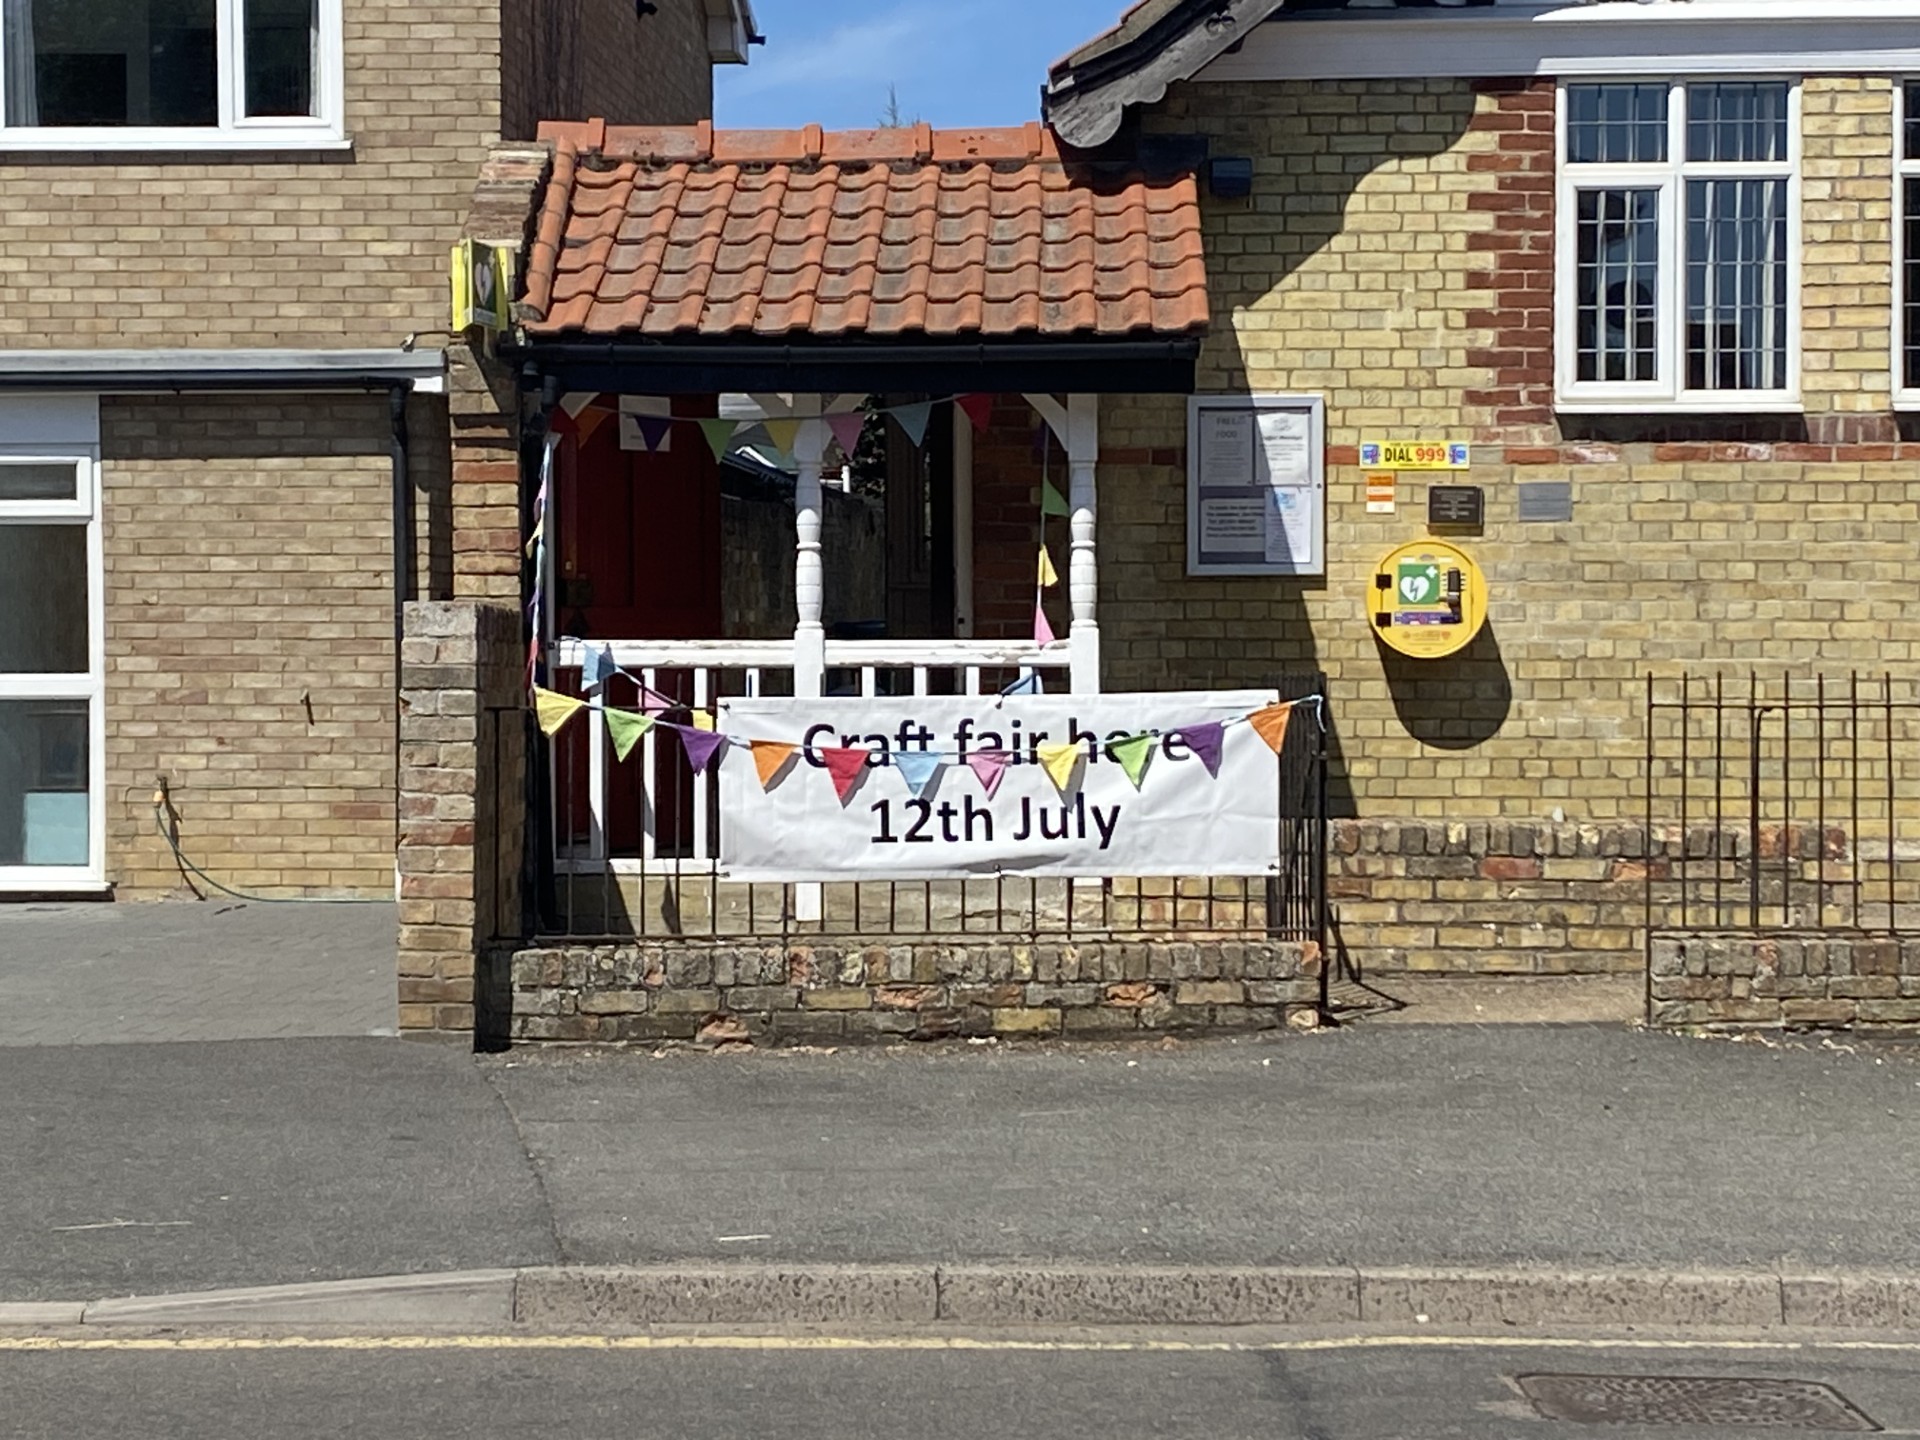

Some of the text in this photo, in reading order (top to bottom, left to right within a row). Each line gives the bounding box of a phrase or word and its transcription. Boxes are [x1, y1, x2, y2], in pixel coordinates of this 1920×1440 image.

[1384, 447, 1446, 462] DIAL 999
[803, 719, 935, 768] Craft
[953, 718, 1049, 765] fair
[870, 791, 1121, 850] 12th July
